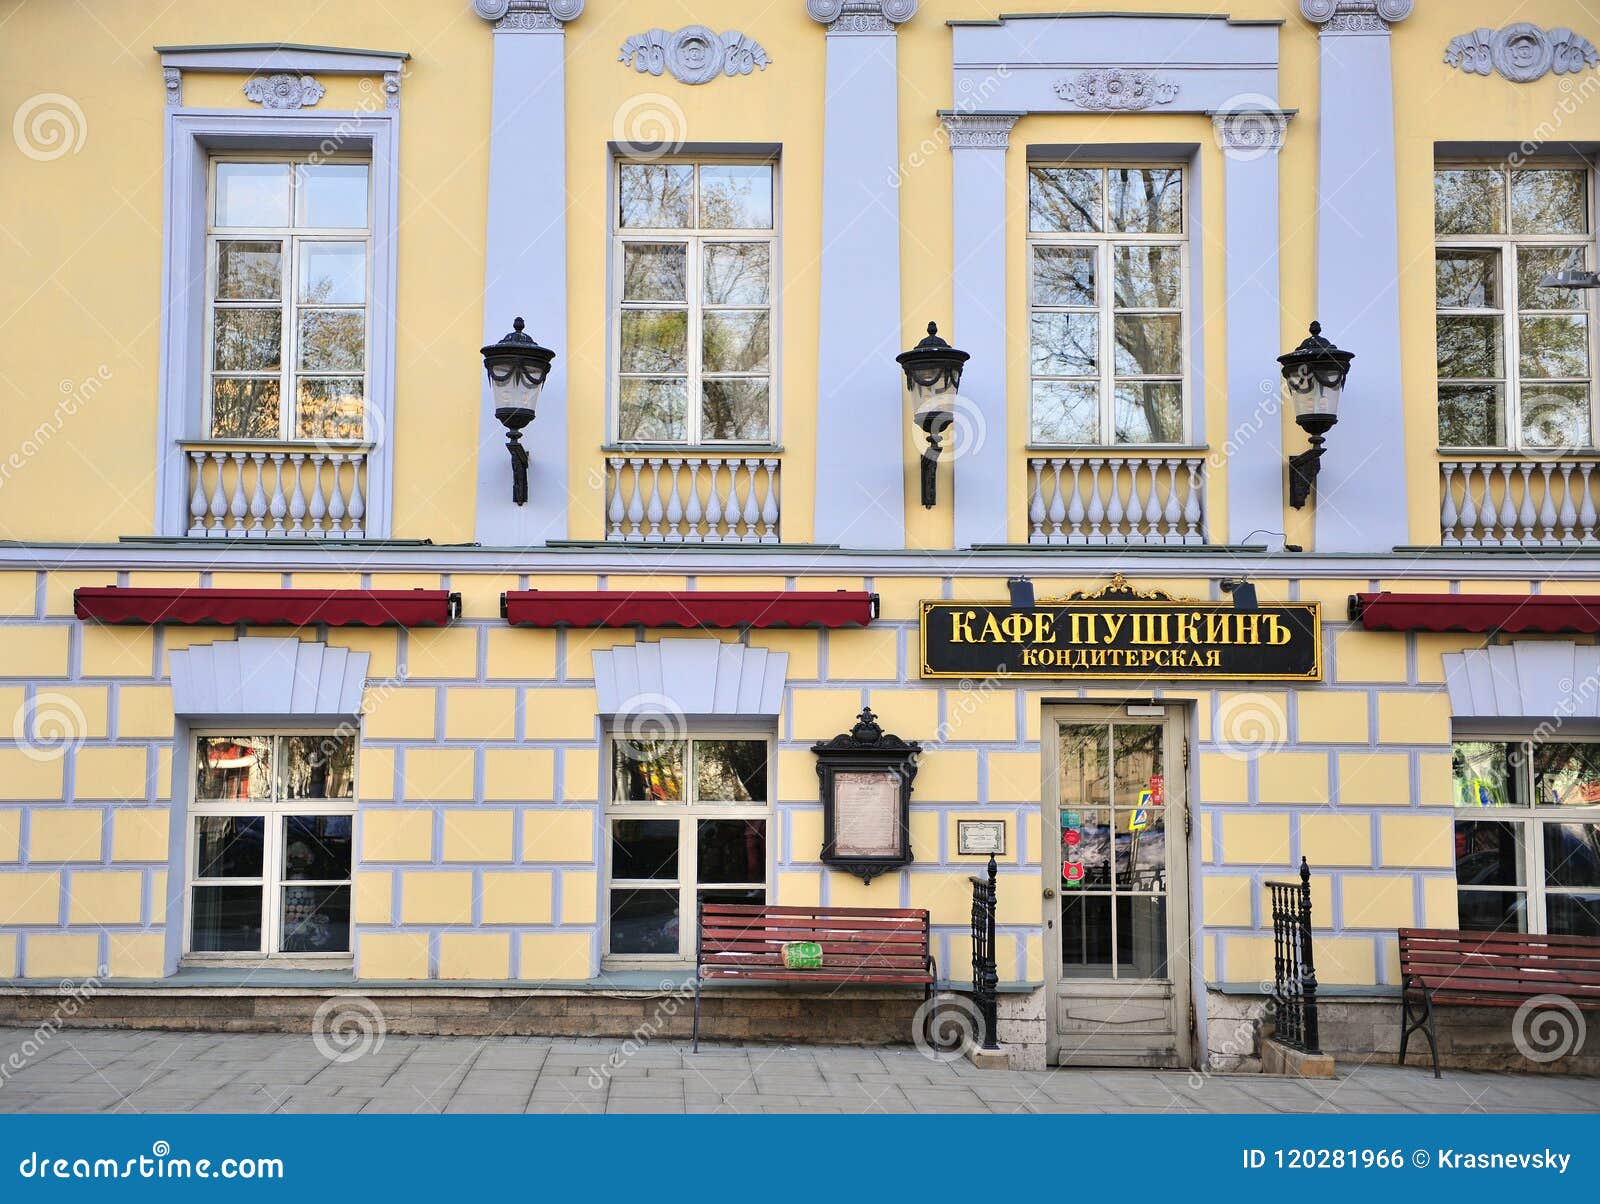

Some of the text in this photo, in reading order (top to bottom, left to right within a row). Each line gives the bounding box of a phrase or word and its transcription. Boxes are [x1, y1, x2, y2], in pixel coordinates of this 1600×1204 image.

[949, 611, 1292, 645] КАФЕ ПУШКИНЪ
[1022, 648, 1221, 669] КОНДИТЕРСКАЯ
